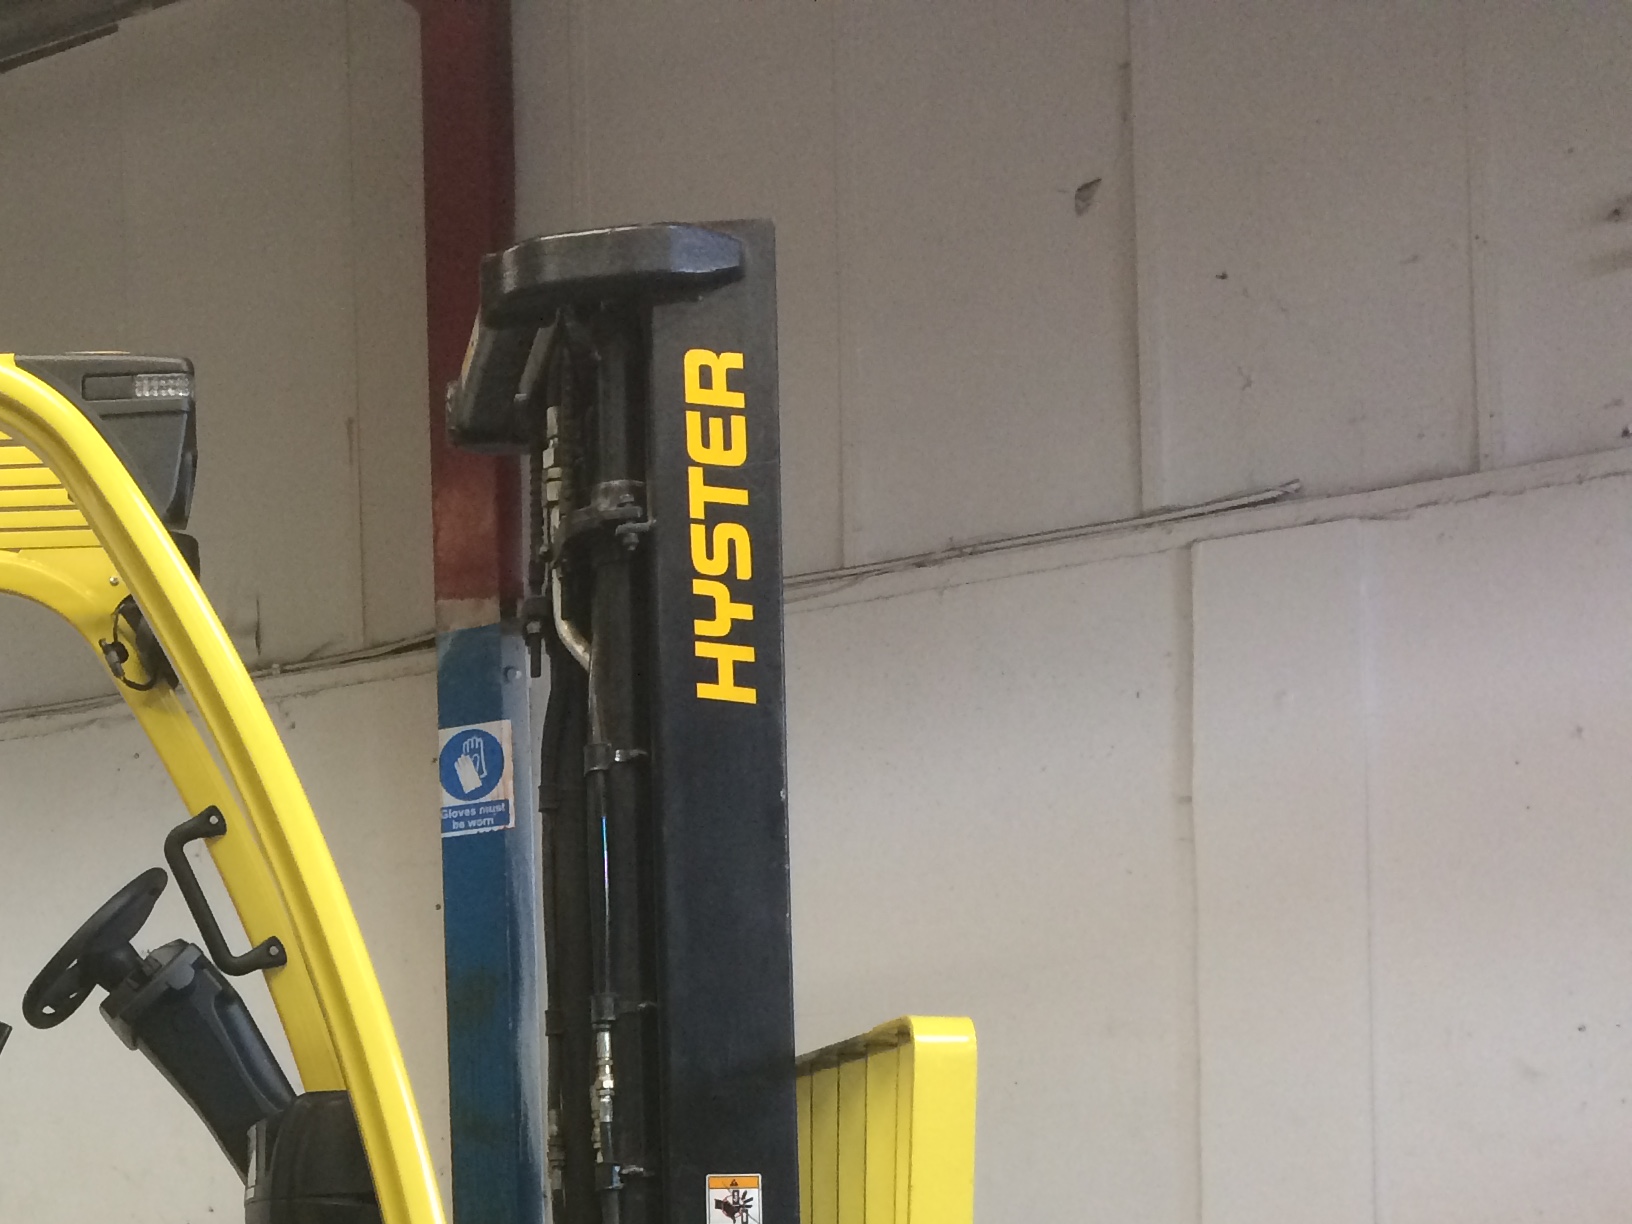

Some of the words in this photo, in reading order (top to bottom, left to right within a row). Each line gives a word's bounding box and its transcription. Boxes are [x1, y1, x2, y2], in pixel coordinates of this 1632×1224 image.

[683, 348, 757, 704] HYSTER
[479, 804, 505, 815] must
[452, 819, 465, 830] be
[468, 818, 494, 827] worn
